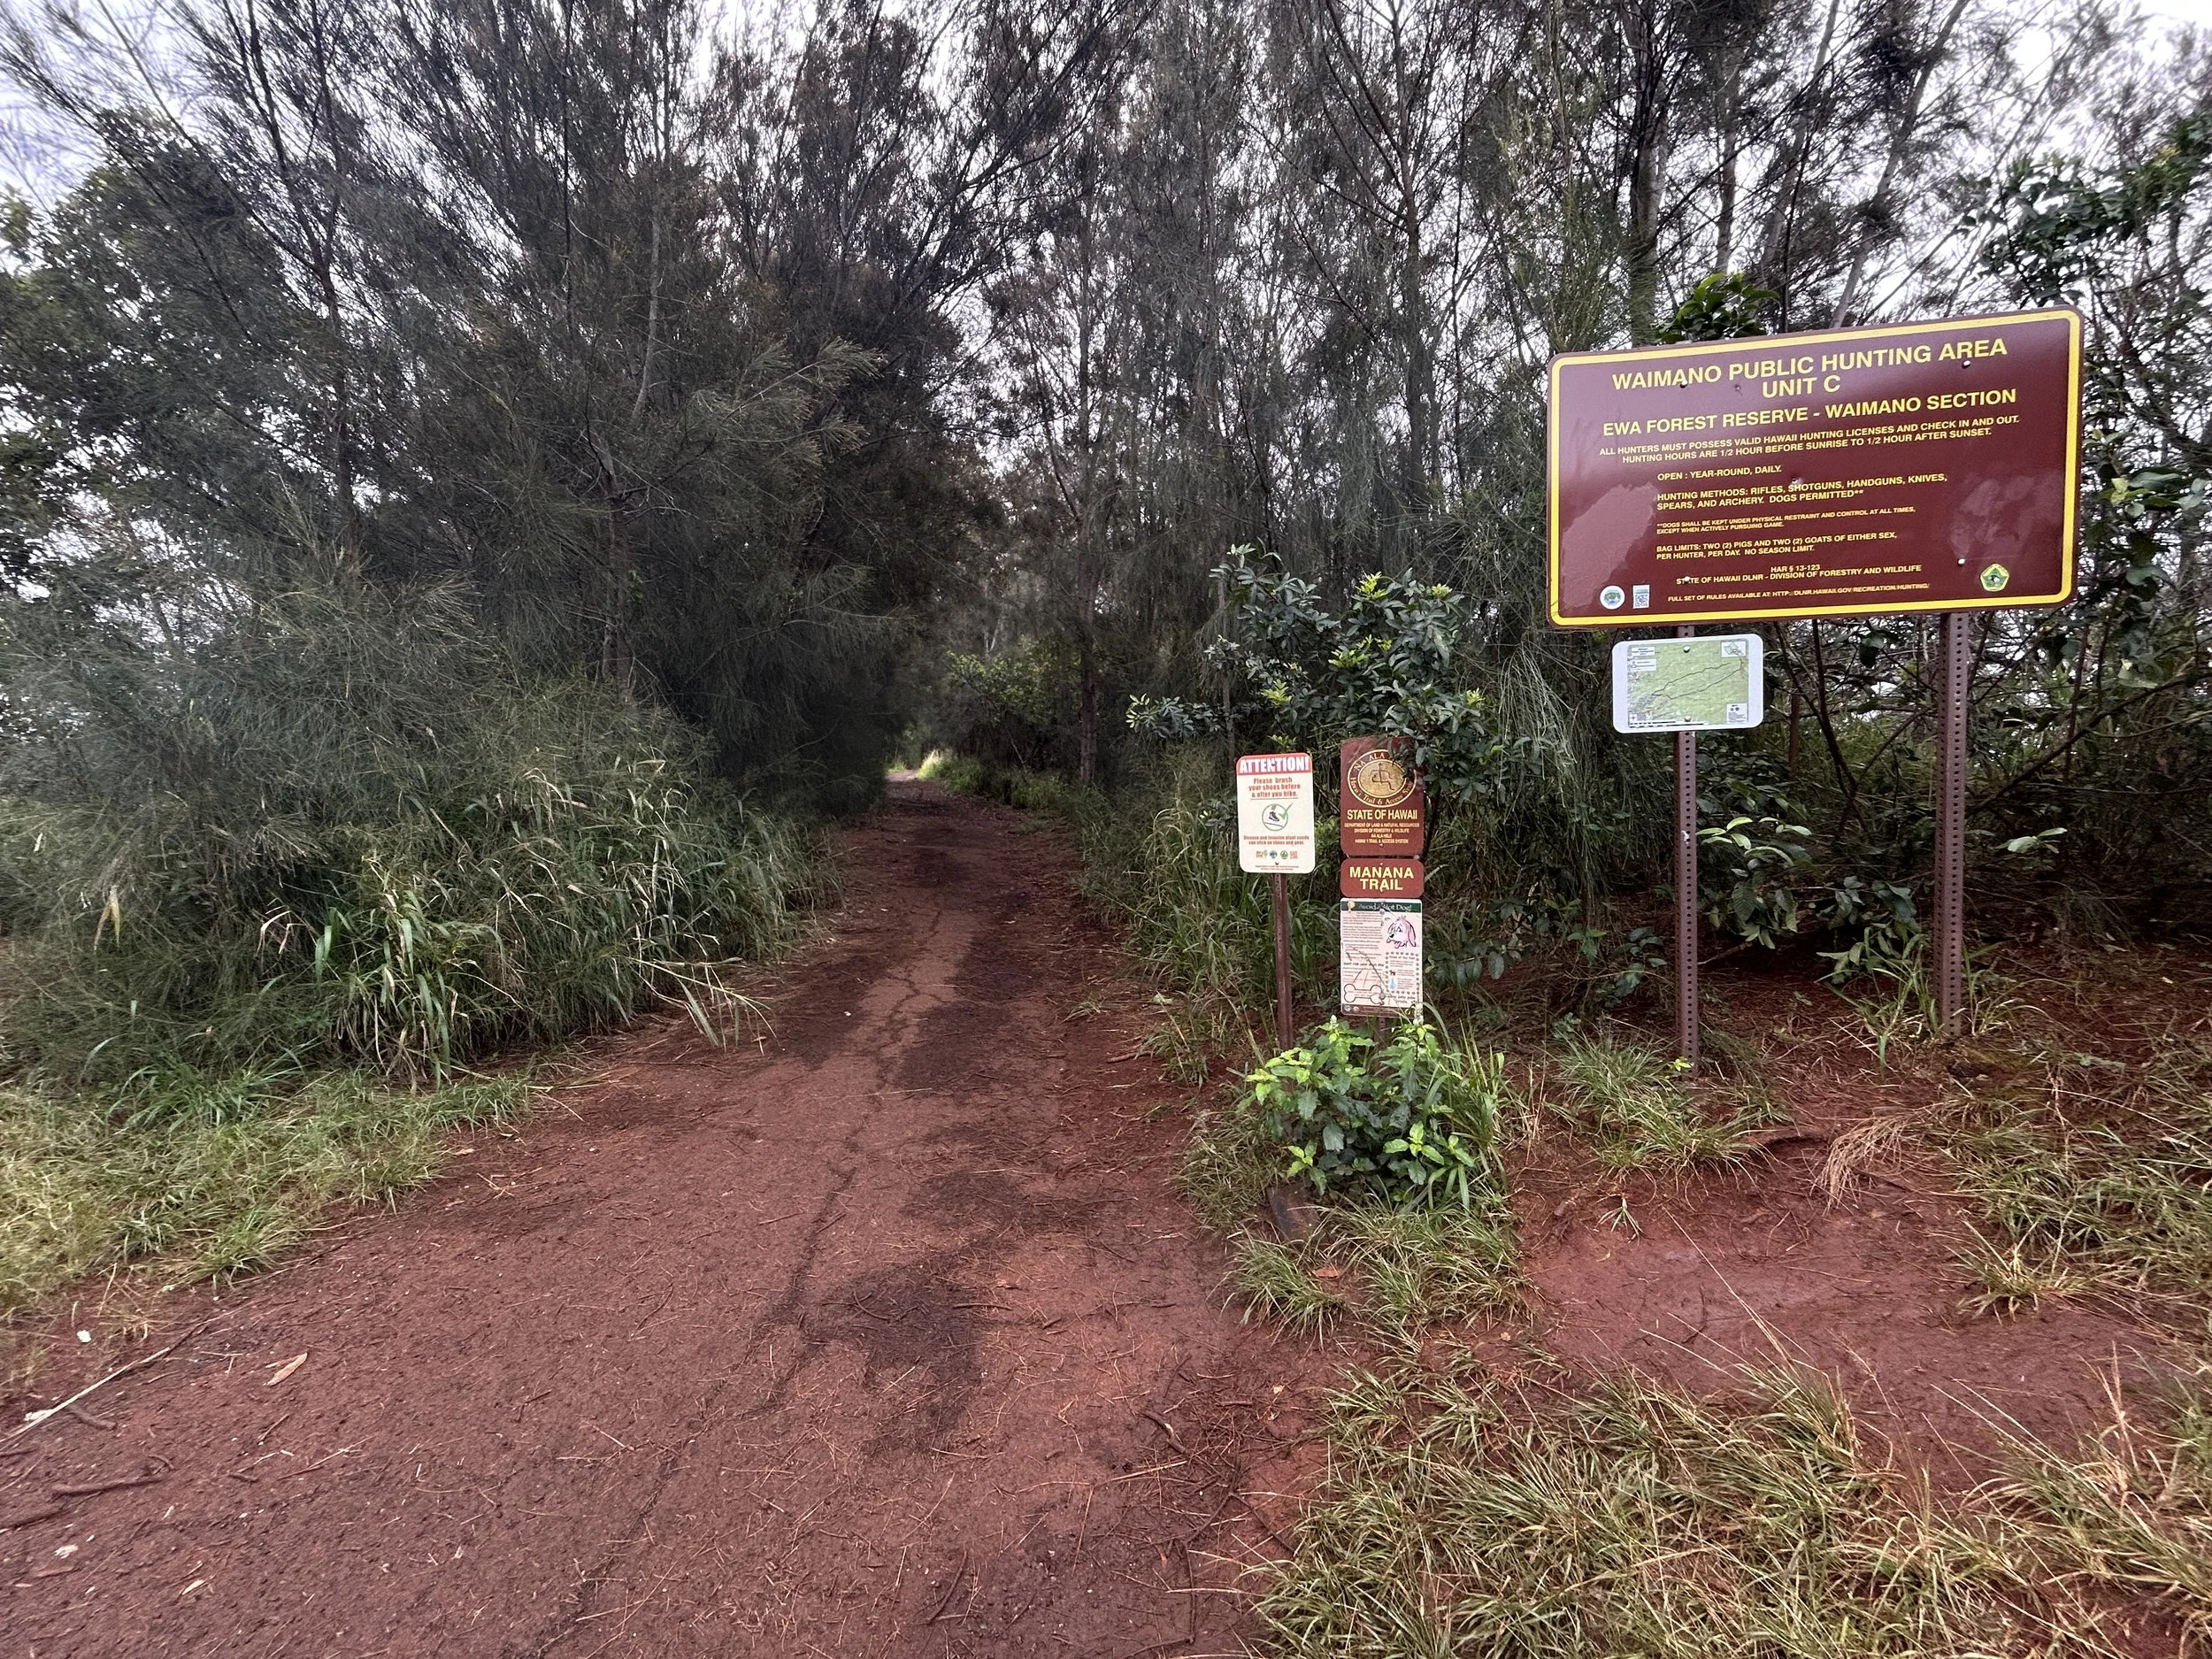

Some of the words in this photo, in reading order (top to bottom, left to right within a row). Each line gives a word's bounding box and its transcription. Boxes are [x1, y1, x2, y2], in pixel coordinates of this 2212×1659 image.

[1612, 365, 1721, 389] WAIMANO
[1729, 356, 1814, 380] PUBLIC
[1821, 345, 1932, 372] HUNTING
[1939, 339, 2008, 361] AREA
[1763, 377, 1817, 398] UNIT
[1824, 375, 1840, 393] C
[1603, 422, 1641, 436] EWA
[1647, 415, 1717, 434] FOREST
[1723, 407, 1808, 427] RESERVE
[1825, 397, 1920, 419] WAIMANO
[1927, 388, 2016, 410] SECTION
[1618, 445, 1659, 454] HUNTERS
[1689, 440, 1732, 449] POSSESS
[1763, 434, 1797, 443] HAWAII
[1800, 430, 1844, 441] HUNTING
[1846, 426, 1894, 436] LICENSES
[1897, 424, 1918, 433] AND
[1920, 420, 1956, 430] CHECK
[1971, 418, 1993, 426] AND
[1996, 415, 2019, 424] OUT.
[1623, 454, 1663, 464] HUNTING
[1721, 449, 1733, 457] 1/2
[1735, 447, 1763, 456] HOUR
[1765, 444, 1803, 454] BEFORE
[1806, 440, 1847, 450] SUNRISE
[1868, 436, 1881, 445] 1/2
[1883, 434, 1912, 443] HOUR
[1915, 432, 1947, 442] AFTER
[1949, 428, 1992, 438] SUNSET.
[1690, 467, 1752, 479] YEAR-ROUND,
[1755, 465, 1782, 474] DAILY.
[1657, 492, 1698, 501] HUNTING
[1701, 489, 1748, 498] METHODS:
[1750, 486, 1786, 495] RIFLES,
[1788, 480, 1844, 492] SHOTGUNS,
[1847, 476, 1905, 488] HANDGUNS,
[1909, 473, 1947, 483] KNIVES,
[1657, 502, 1695, 511] SPEARS,
[1697, 499, 1717, 508] AND
[1719, 496, 1764, 506] ARCHERY.
[1770, 494, 1797, 503] DOGS
[1240, 756, 1310, 773] ATTENTION!
[1354, 760, 1366, 771] NA
[1348, 810, 1372, 819] STATE
[1375, 810, 1386, 819] OF
[1388, 810, 1417, 819] HAWAII
[1350, 867, 1414, 878] MANANA
[1360, 879, 1403, 890] TRAIL
